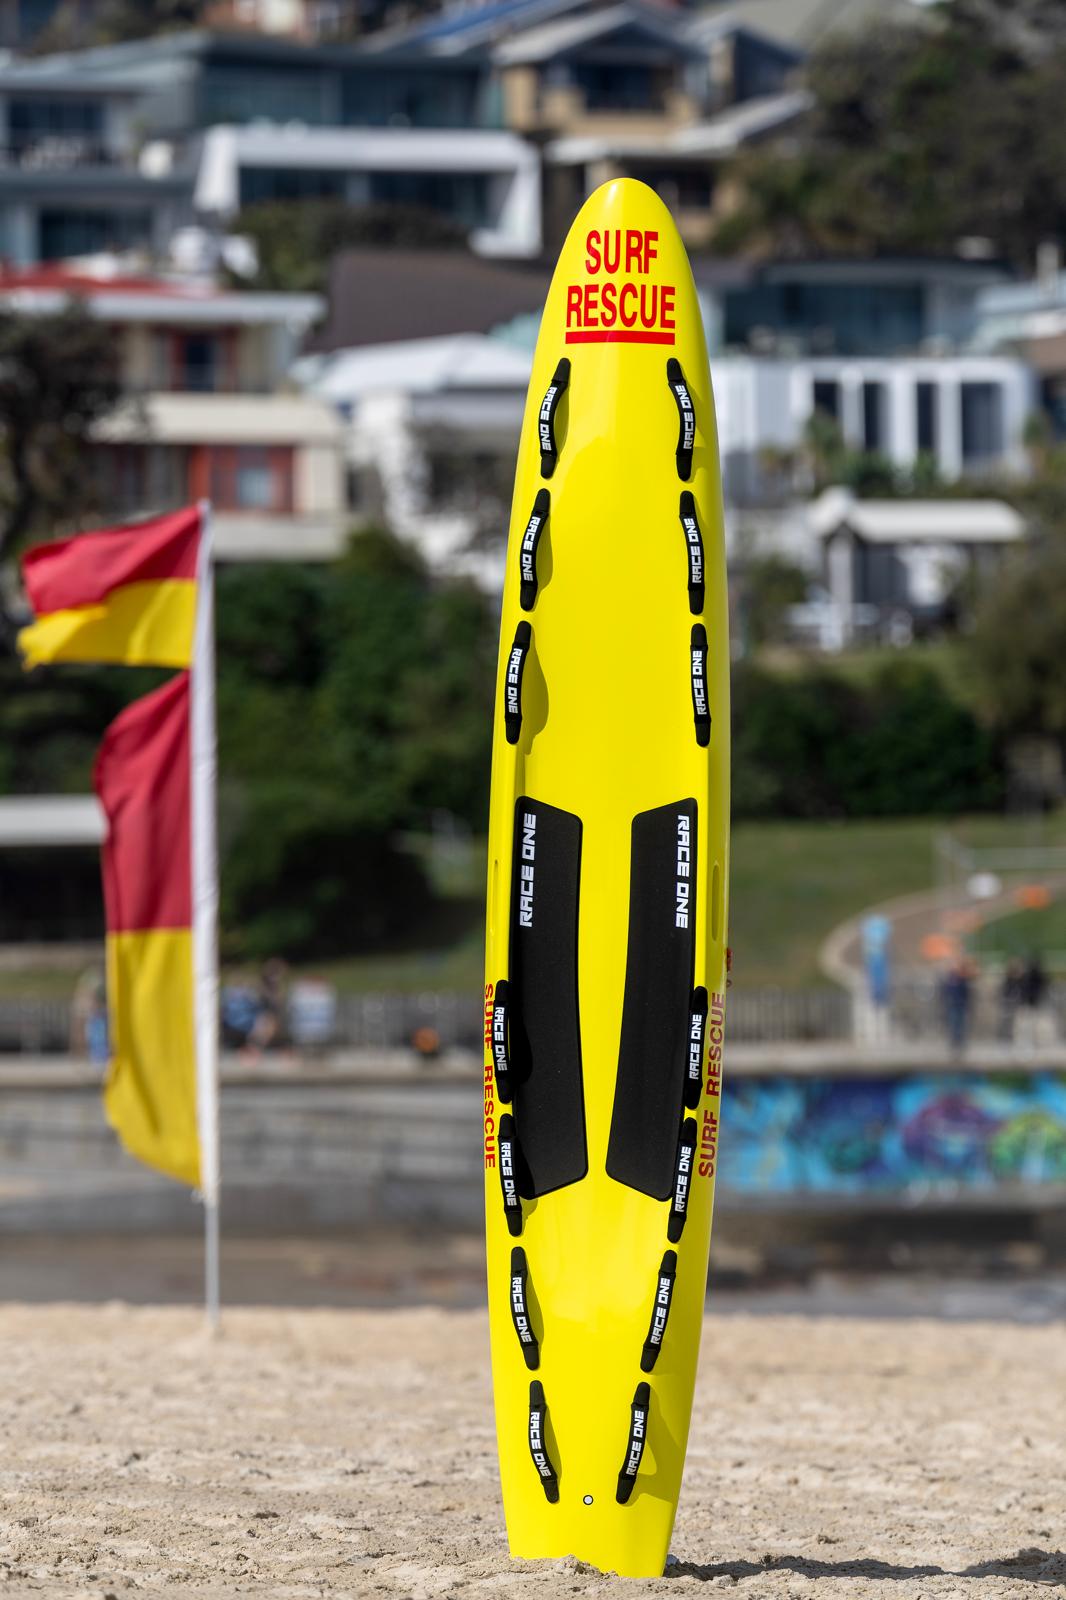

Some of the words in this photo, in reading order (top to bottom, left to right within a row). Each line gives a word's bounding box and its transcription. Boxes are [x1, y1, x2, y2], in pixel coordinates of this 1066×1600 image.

[585, 229, 659, 275] SURF
[566, 282, 676, 329] RESCUE
[540, 386, 557, 420] RACE
[675, 384, 692, 409] ONE
[540, 421, 552, 451] ONE
[683, 412, 693, 450] RACE
[524, 516, 541, 551] RACE
[684, 517, 700, 543] ONE
[522, 553, 534, 582] ONE
[691, 545, 702, 583] RACE
[508, 648, 523, 684] RACE
[692, 650, 702, 676] ONE
[507, 686, 519, 714] ONE
[693, 678, 707, 715] RACE
[521, 812, 537, 861] ONE
[676, 814, 690, 877] RACE
[519, 865, 535, 928] RACE
[675, 881, 689, 929] ONE
[484, 983, 494, 1050] SURF
[494, 1006, 505, 1042] RACE
[690, 1014, 702, 1041] ONE
[495, 1044, 508, 1072] ONE
[688, 1043, 701, 1080] RACE
[706, 992, 725, 1097] RESCUE
[484, 1065, 496, 1168] RESCUE
[500, 1142, 513, 1177] RACE
[678, 1145, 692, 1173] ONE
[699, 1110, 718, 1178] SURF
[503, 1179, 518, 1207] ONE
[674, 1175, 688, 1213] RACE
[512, 1276, 525, 1313] RACE
[650, 1308, 667, 1345] RACE
[659, 1277, 671, 1306] ONE
[516, 1316, 533, 1344] ONE
[528, 1411, 542, 1450] RACE
[633, 1410, 645, 1439] ONE
[533, 1452, 552, 1478] ONE
[625, 1441, 643, 1476] RACE
